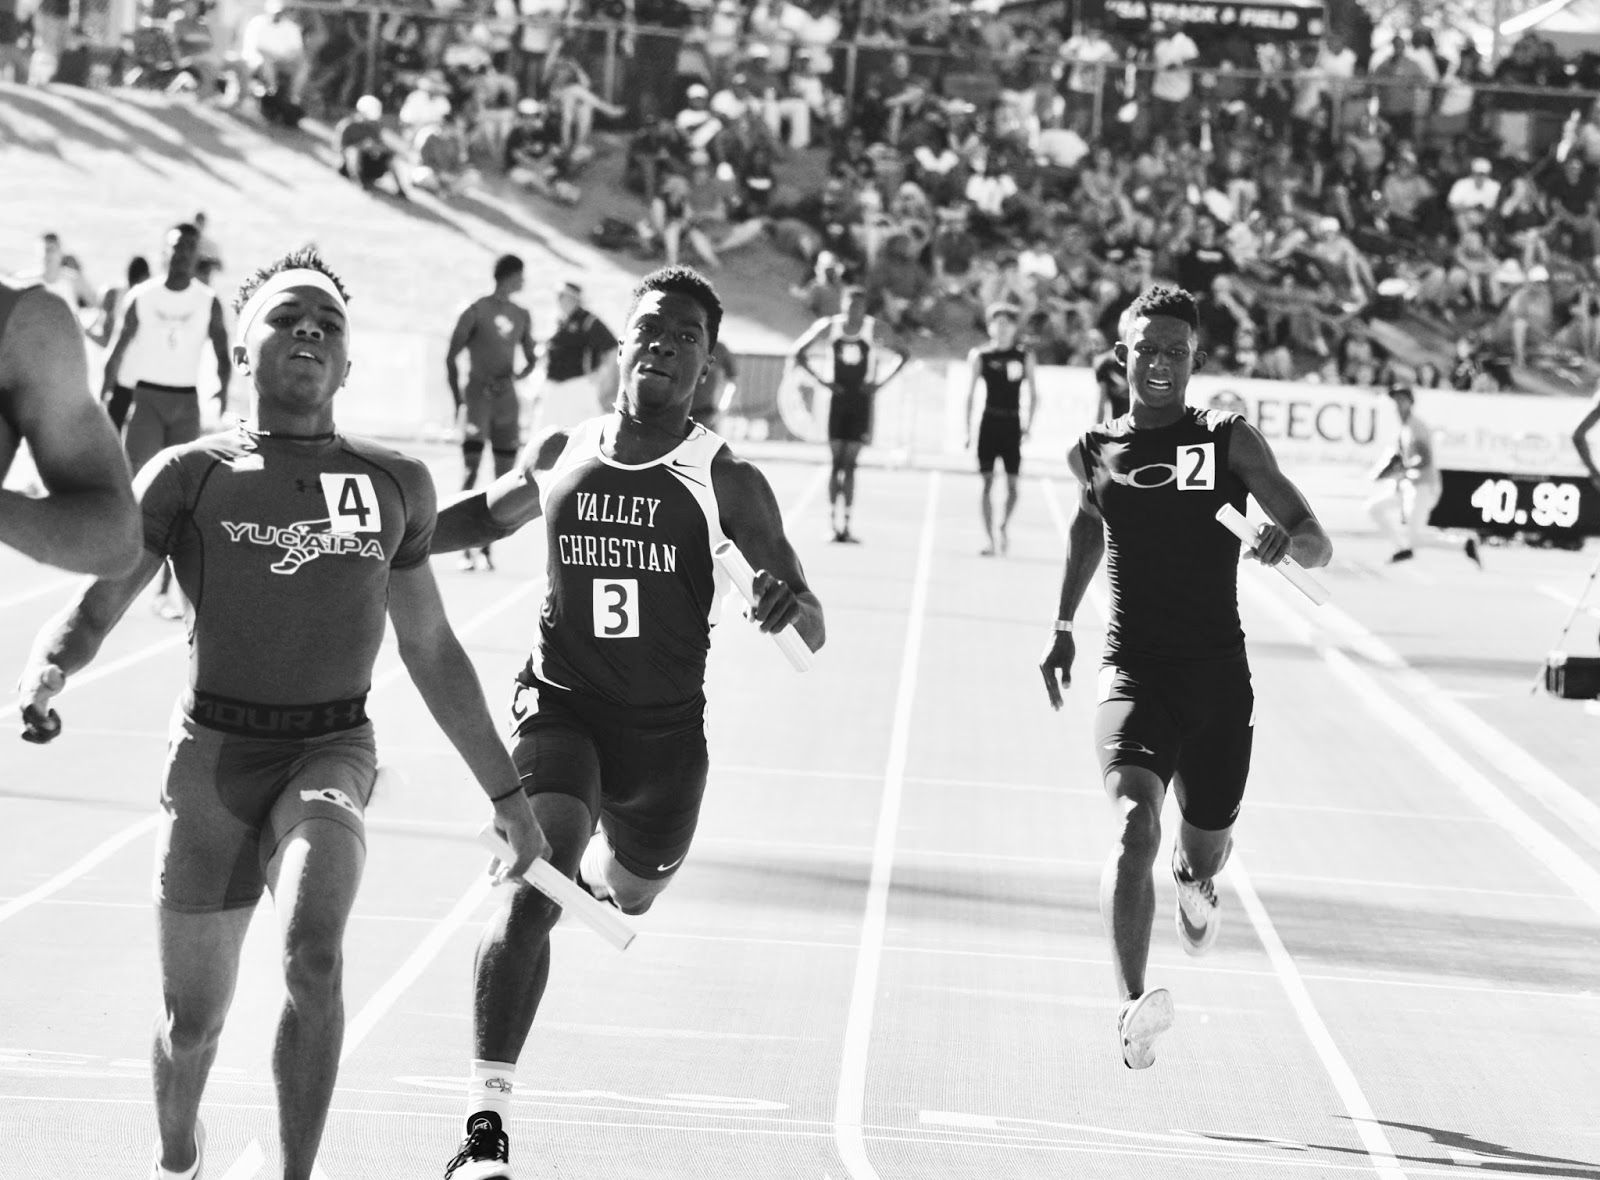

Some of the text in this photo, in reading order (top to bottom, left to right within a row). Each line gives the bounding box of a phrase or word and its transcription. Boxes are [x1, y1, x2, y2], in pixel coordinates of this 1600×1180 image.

[1151, 3, 1218, 24] TRACK
[1239, 8, 1298, 30] FIELD
[1256, 399, 1376, 445] EECU
[1184, 446, 1208, 487] 2
[337, 477, 371, 527] 4
[576, 491, 662, 528] VALLEY
[1471, 478, 1581, 528] 40.99
[220, 520, 386, 561] YUCAIPA
[558, 534, 677, 573] CHRISTIAN
[603, 583, 629, 636] 3
